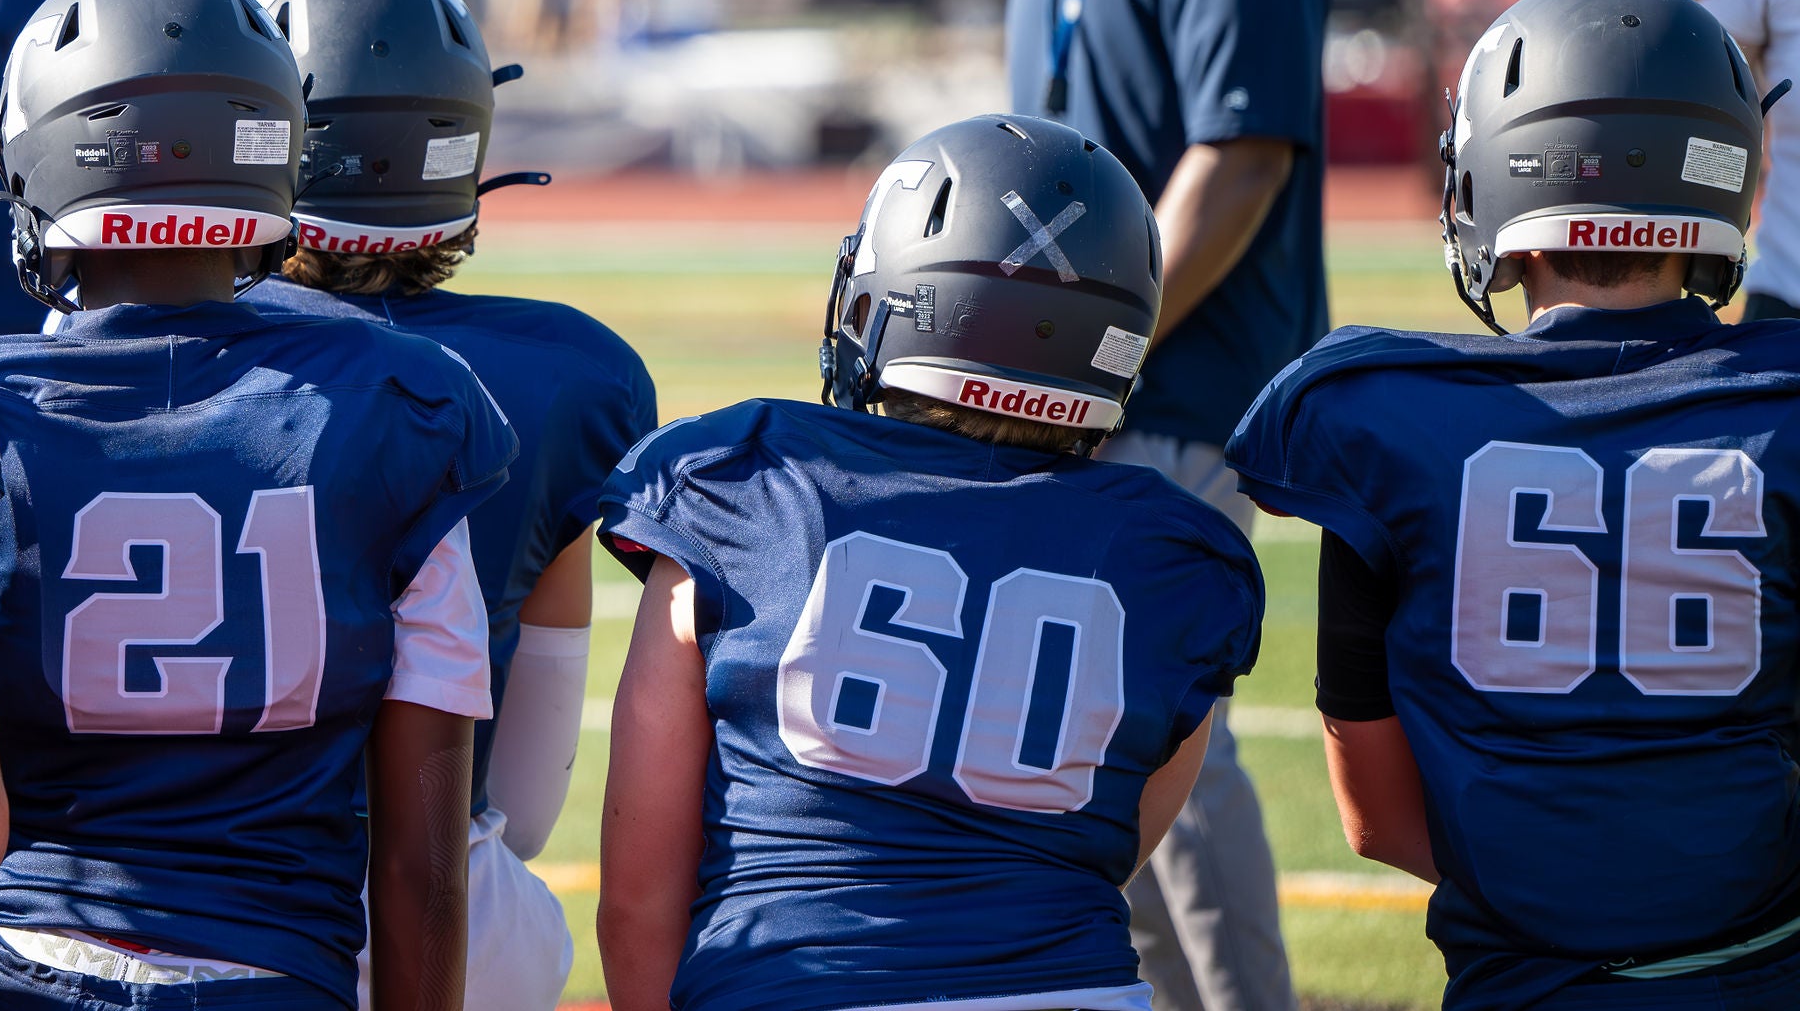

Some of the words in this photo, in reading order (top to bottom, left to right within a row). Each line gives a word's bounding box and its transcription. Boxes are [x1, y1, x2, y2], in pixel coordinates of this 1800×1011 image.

[101, 213, 258, 245] Riddell
[299, 222, 444, 254] Riddell
[1568, 220, 1700, 248] Riddell
[959, 379, 1091, 424] Riddell
[1450, 440, 1768, 697] 66
[61, 485, 327, 735] 21
[777, 531, 1126, 814] 60
